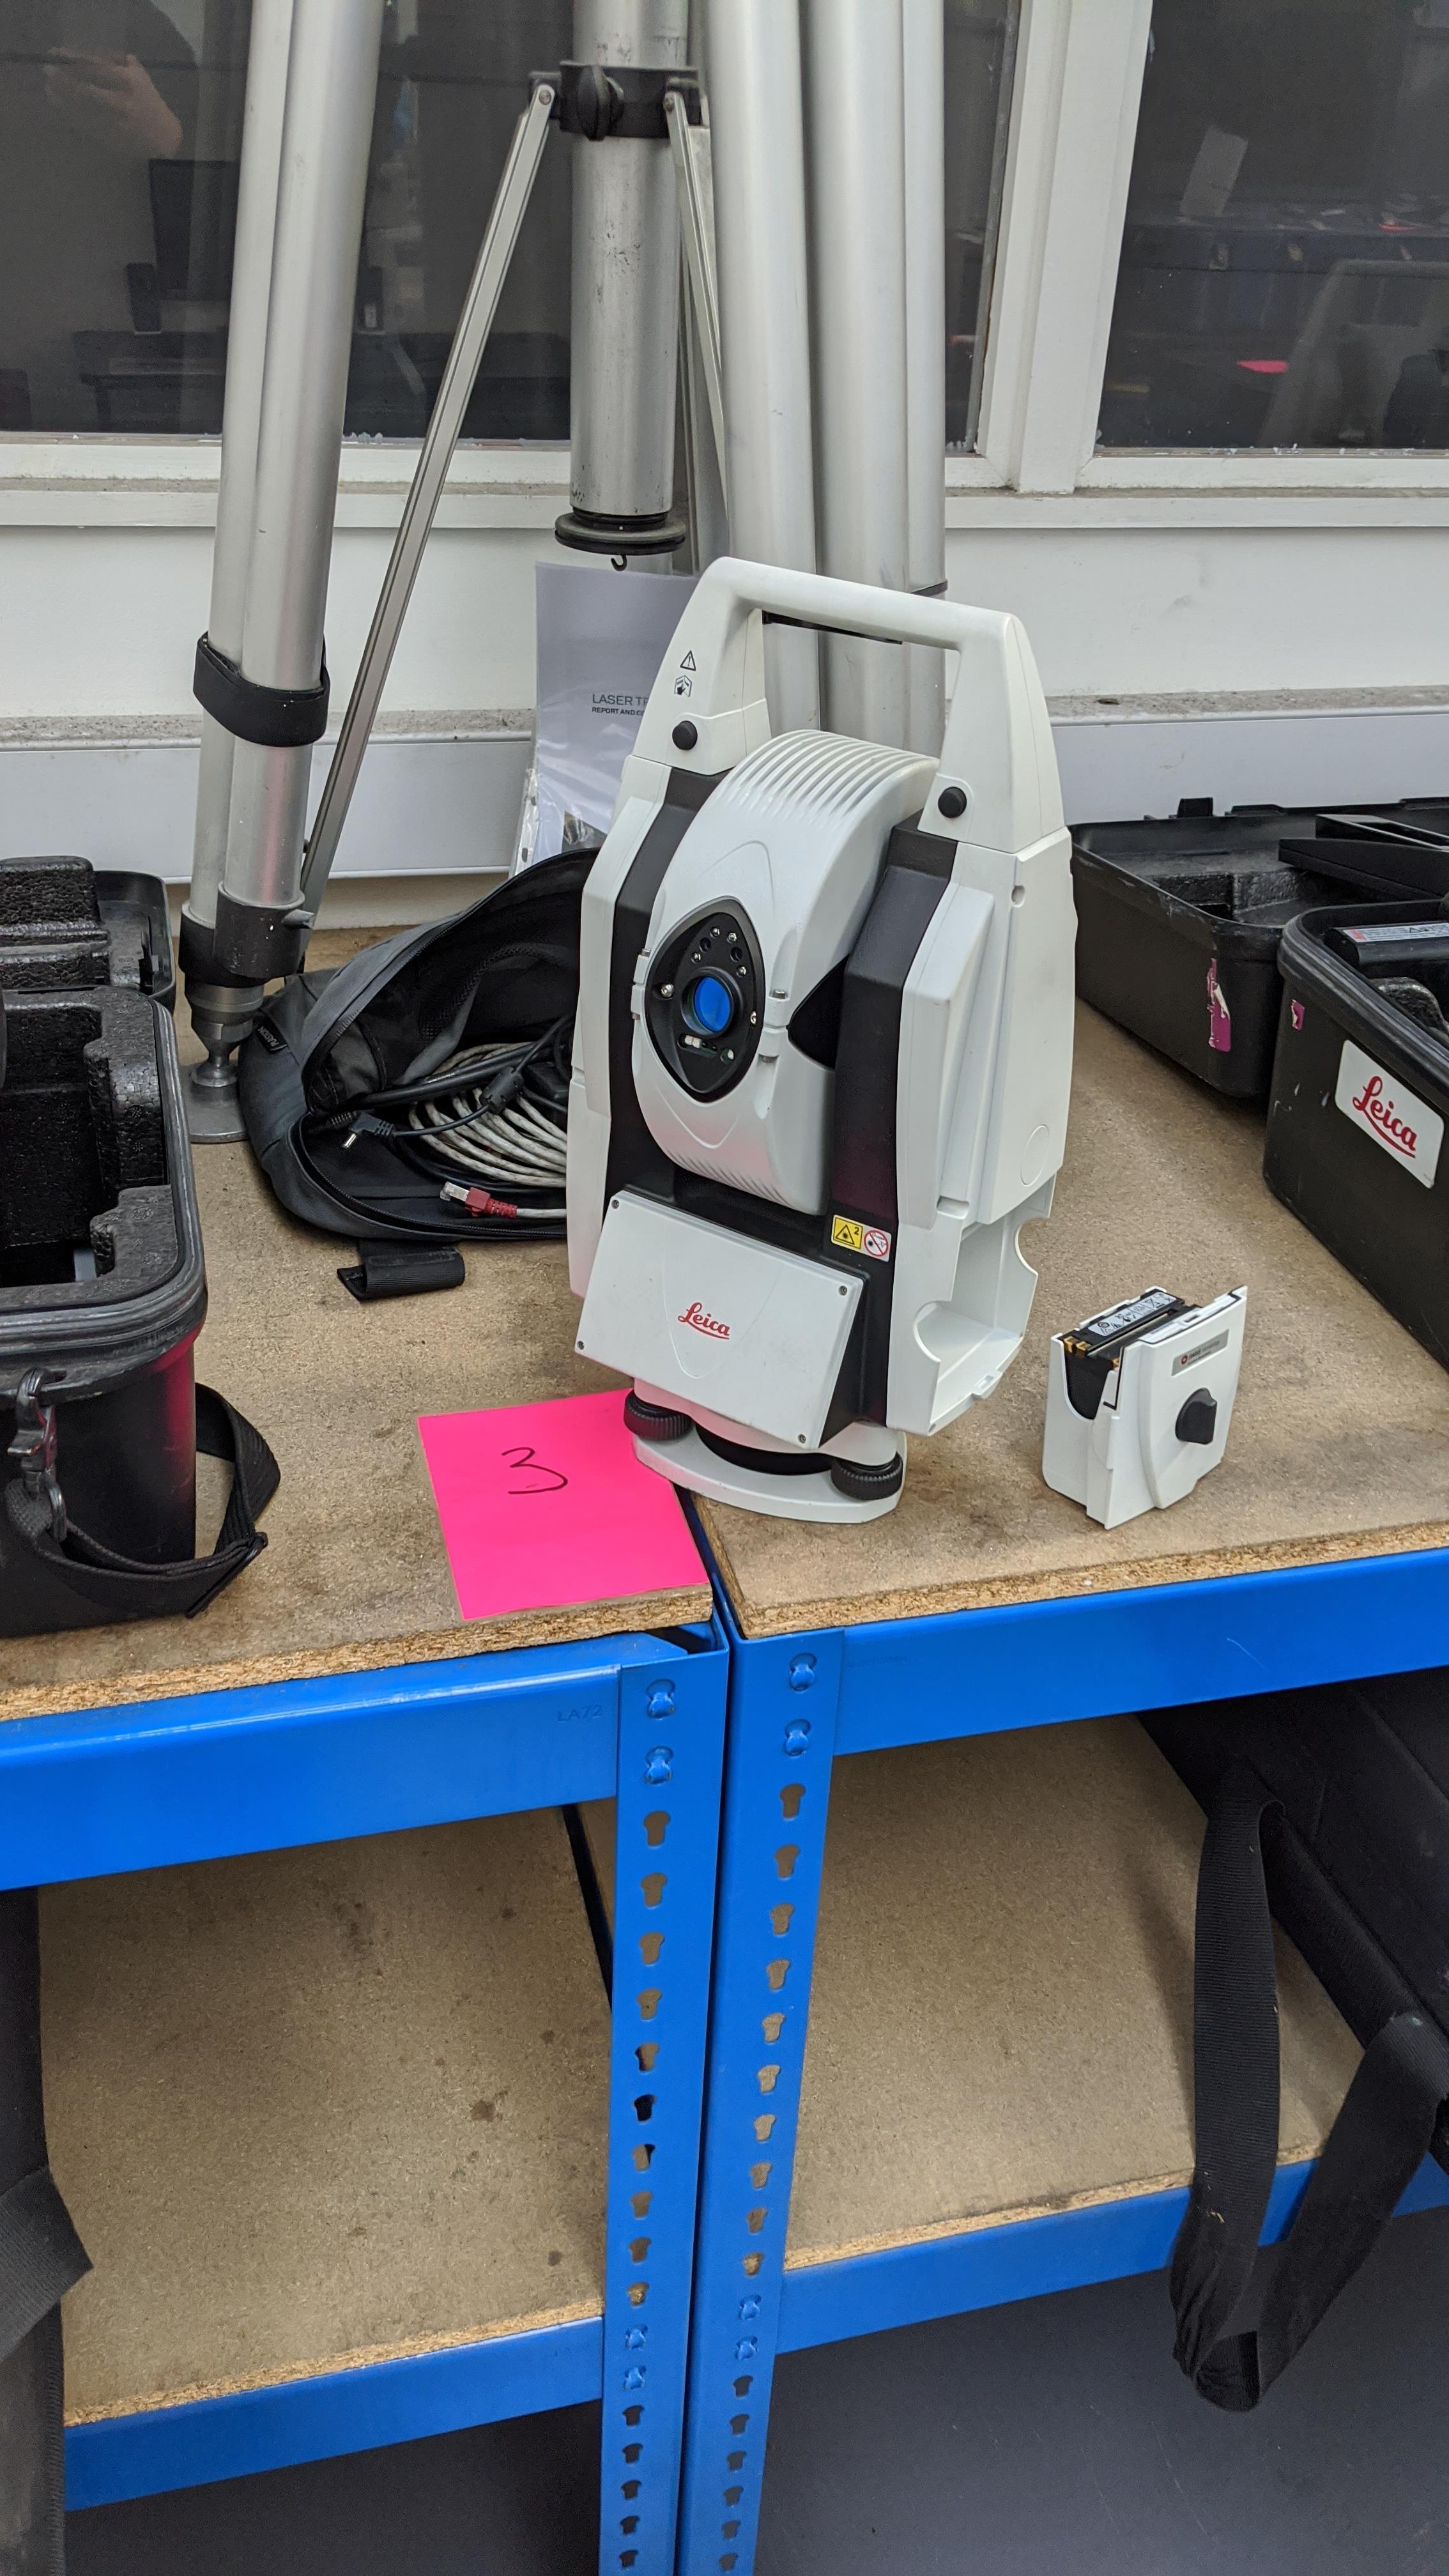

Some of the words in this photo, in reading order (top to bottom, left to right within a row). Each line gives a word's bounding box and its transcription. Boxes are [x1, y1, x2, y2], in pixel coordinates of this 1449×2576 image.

[592, 694, 633, 706] LASER
[1353, 1075, 1416, 1159] Leica
[854, 1227, 860, 1236] 2
[677, 1301, 730, 1340] Leica
[501, 1446, 569, 1495] 3
[557, 1704, 602, 1722] LA72
